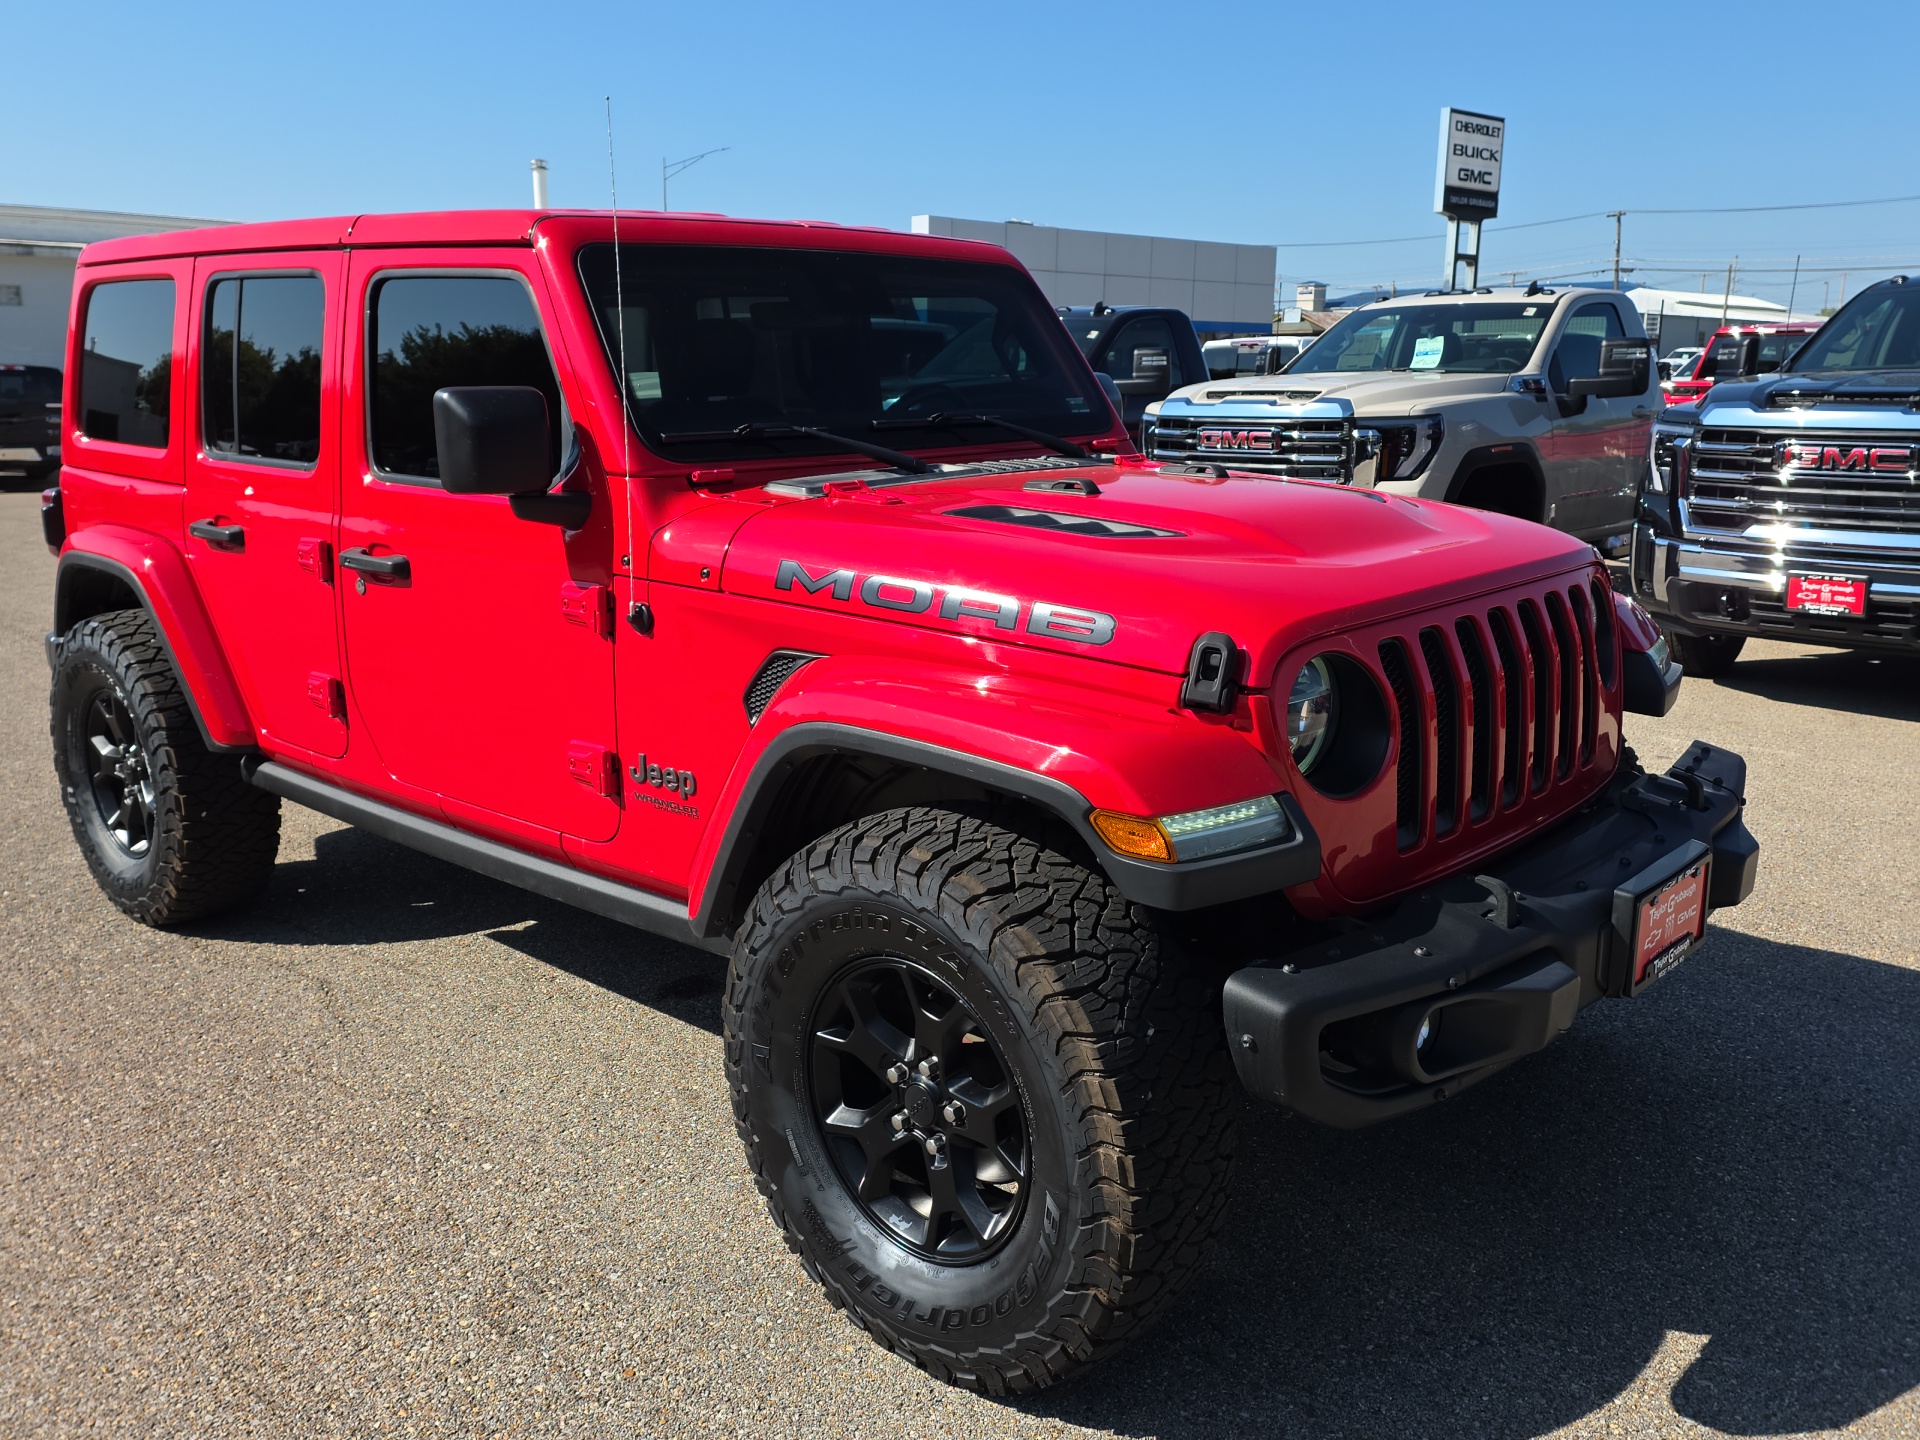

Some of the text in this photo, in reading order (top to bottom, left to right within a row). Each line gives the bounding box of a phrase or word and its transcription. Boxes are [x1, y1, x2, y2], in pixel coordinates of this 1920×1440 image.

[1455, 120, 1501, 138] CHEVROLET
[1453, 143, 1499, 162] BUICK
[1458, 168, 1493, 185] GMC
[1201, 431, 1273, 449] GMC
[1783, 446, 1911, 471] GMC
[774, 559, 1118, 647] MOAB
[629, 753, 697, 800] Jeep
[633, 790, 699, 816] WRANGLER
[1649, 882, 1697, 927] Taylor Grubaugh
[1677, 904, 1697, 925] GMC
[1654, 954, 1669, 974] Taylor
[845, 1190, 1061, 1333] BFGoodrich
